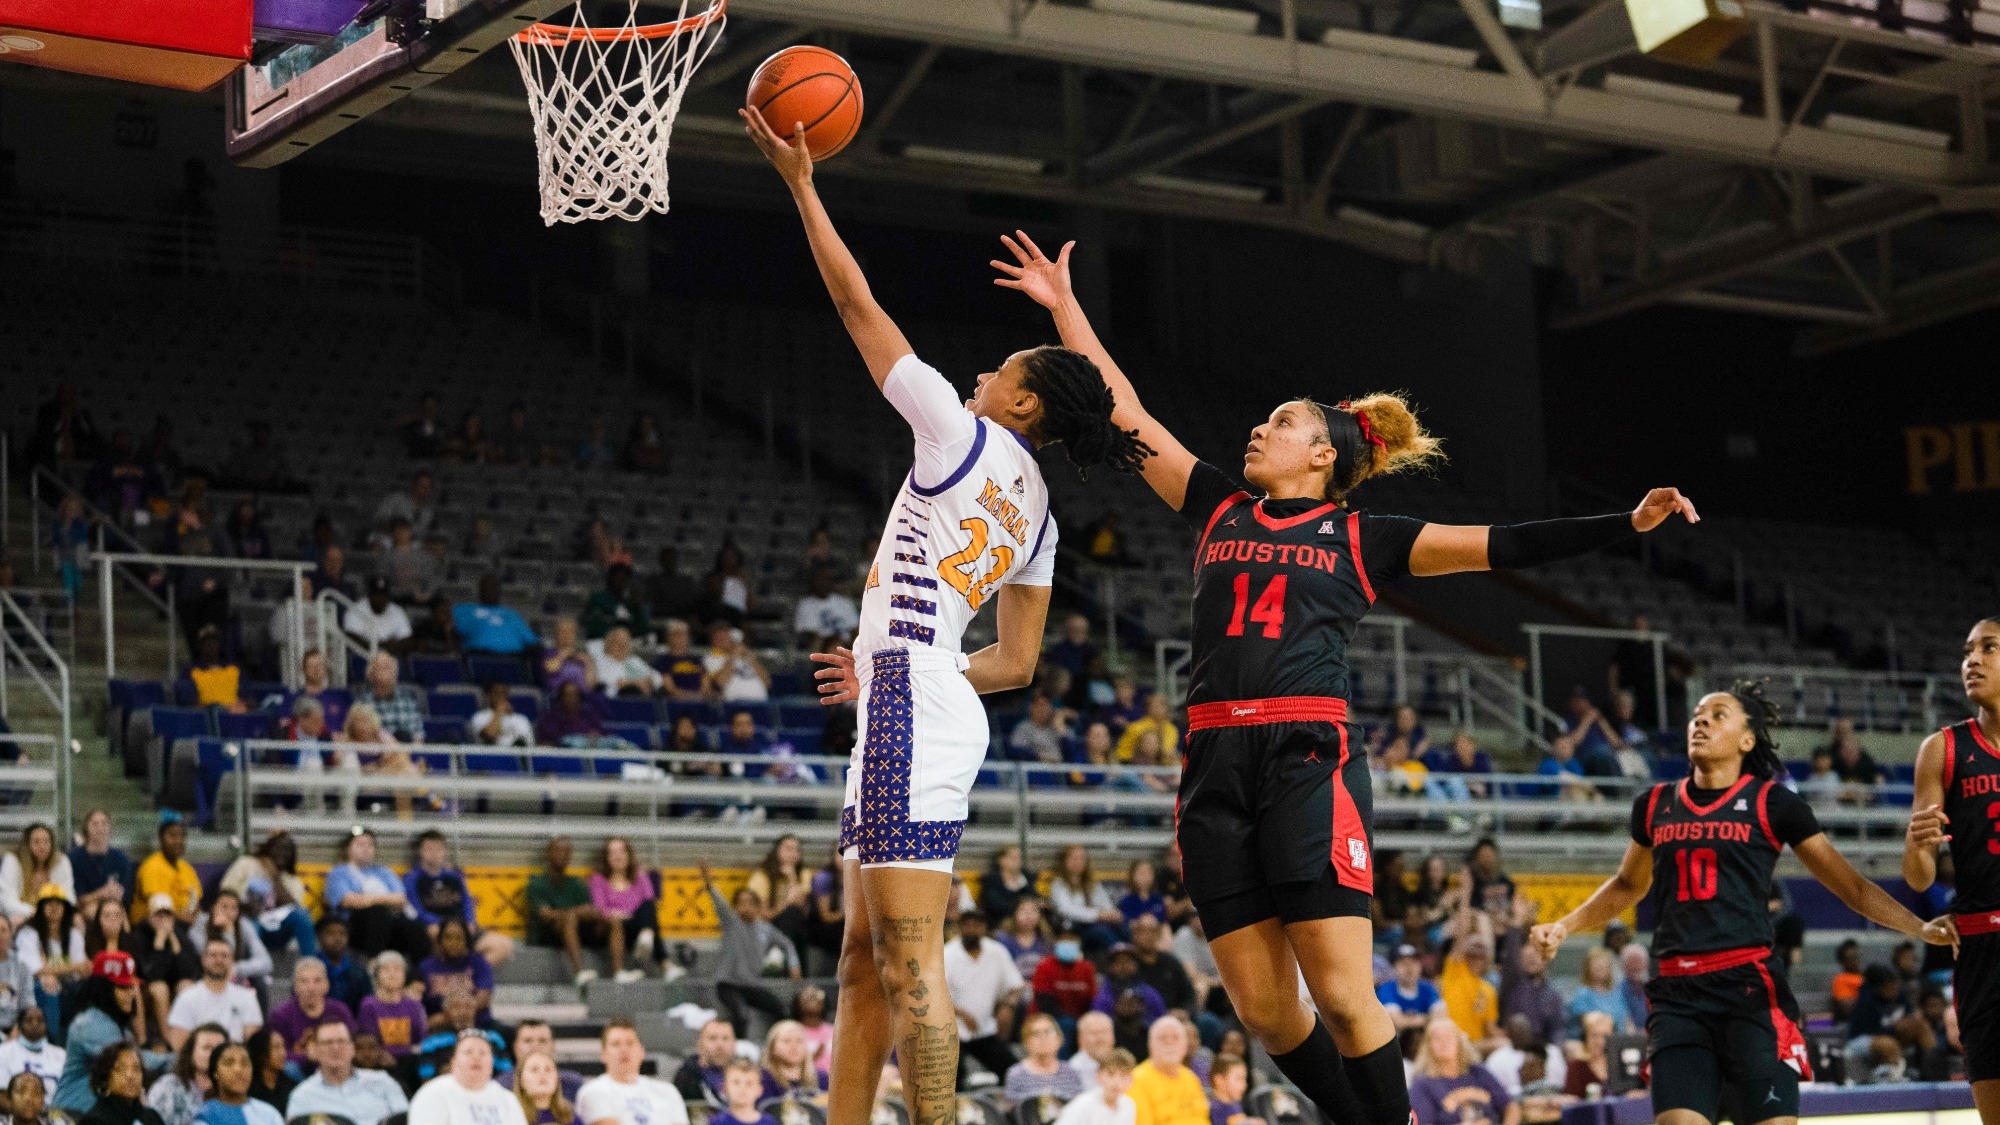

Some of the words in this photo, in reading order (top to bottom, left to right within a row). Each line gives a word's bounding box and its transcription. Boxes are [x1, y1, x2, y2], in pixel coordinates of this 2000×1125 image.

[937, 517, 1014, 611] 22
[1204, 540, 1339, 574] HOUSTON
[1226, 572, 1288, 639] 14
[1231, 707, 1257, 717] Cougars
[1653, 821, 1752, 847] HOUSTON
[1675, 848, 1717, 902] 10
